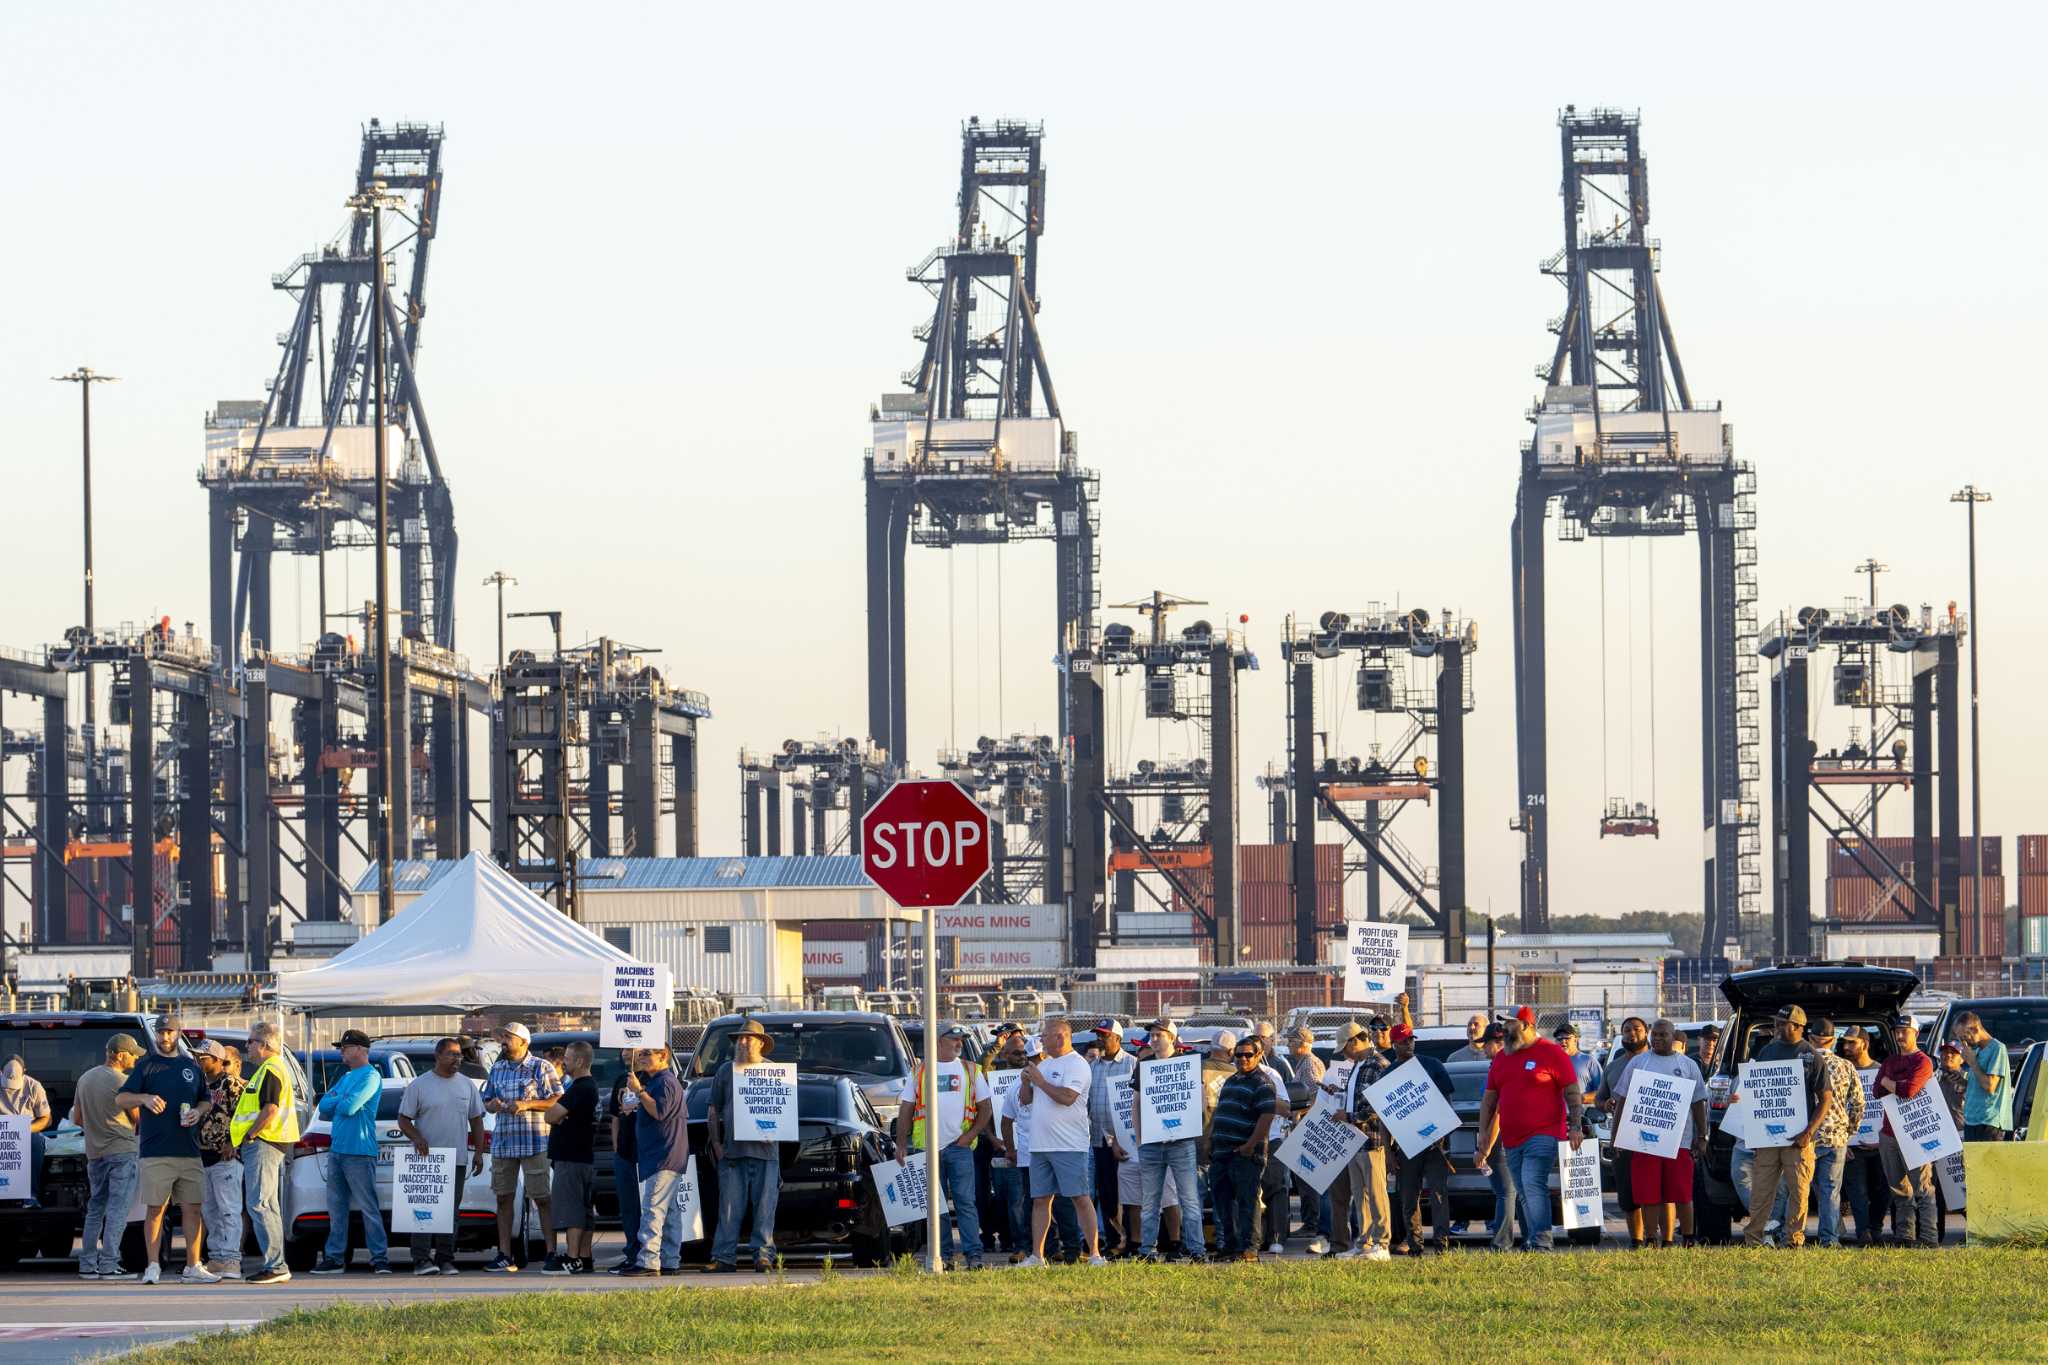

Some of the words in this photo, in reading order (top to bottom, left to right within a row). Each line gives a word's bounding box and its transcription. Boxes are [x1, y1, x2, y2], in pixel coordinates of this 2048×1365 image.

[1528, 794, 1544, 806] 214
[872, 821, 980, 868] STOP
[944, 916, 984, 928] YANG
[990, 916, 1031, 928] MING
[1359, 928, 1380, 936] PROFIT
[1382, 929, 1398, 938] OVER
[1362, 938, 1385, 946] PEOPLE
[960, 952, 984, 964] NG
[990, 952, 1031, 964] MING
[1352, 946, 1402, 958] UNACCEPTABLE:
[803, 953, 843, 964] MING
[1357, 957, 1384, 966] SUPPORT
[616, 966, 654, 976] MACHINES
[1360, 967, 1391, 976] WORKERS
[614, 979, 635, 987] DON'T
[638, 980, 654, 988] FEED
[616, 990, 652, 999] FAMILIES:
[610, 1002, 642, 1011] SUPPORT
[646, 1003, 657, 1012] ILA
[616, 1014, 652, 1023] WORKERS
[1150, 1064, 1172, 1075] PROFIT
[1174, 1062, 1190, 1072] OVER
[1750, 1066, 1792, 1078] AUTOMATION
[748, 1078, 773, 1086] PEOPLE
[1156, 1074, 1178, 1084] PEOPLE
[1180, 1072, 1186, 1080] IS
[1744, 1080, 1766, 1088] HURTS
[1767, 1076, 1800, 1086] FAMILIES:
[1146, 1081, 1196, 1096] UNACCEPTABLE:
[1653, 1079, 1672, 1090] FIGHT
[739, 1087, 792, 1096] UNACCEPTABLE:
[1386, 1092, 1396, 1103] NO
[1395, 1080, 1416, 1096] WORK
[1638, 1086, 1681, 1102] AUTOMATION,
[1754, 1090, 1765, 1098] ILA
[1766, 1088, 1792, 1098] STANDS
[744, 1096, 774, 1104] SUPPORT
[1152, 1093, 1179, 1104] SUPPORT
[1181, 1092, 1191, 1100] ILA
[1382, 1096, 1410, 1117] WITHOUT
[1414, 1082, 1430, 1096] FAIR
[1640, 1096, 1657, 1107] SAVE
[1657, 1100, 1676, 1110] JOBS:
[1760, 1099, 1774, 1108] FOR
[1774, 1098, 1786, 1108] JOB
[749, 1106, 782, 1114] WORKERS
[1156, 1102, 1188, 1114] WORKERS
[1396, 1096, 1428, 1120] CONTRACT
[1898, 1101, 1916, 1115] DON'T
[1916, 1096, 1932, 1109] FEED
[1633, 1105, 1644, 1114] ILA
[1645, 1108, 1678, 1120] DEMANDS
[1754, 1108, 1795, 1119] PROTECTION
[1904, 1106, 1934, 1122] FAMILIES:
[1630, 1114, 1642, 1124] JOB
[1643, 1117, 1676, 1130] SECURITY
[1903, 1116, 1930, 1133] SUPPORT
[1930, 1113, 1941, 1124] ILA
[1320, 1120, 1340, 1140] PEOPLE
[1340, 1135, 1346, 1144] IS
[1340, 1123, 1356, 1140] OVER
[1910, 1123, 1940, 1140] WORKERS
[1305, 1120, 1348, 1156] UNACCEPTABLE:
[1304, 1130, 1330, 1154] SUPPORT
[1328, 1150, 1338, 1161] ILA
[1302, 1140, 1330, 1164] WORKERS
[428, 1154, 445, 1163] OVER
[409, 1164, 432, 1173] PEOPLE
[434, 1164, 440, 1173] IS
[399, 1174, 449, 1184] UNACCEPTABLE:
[1568, 1178, 1584, 1188] DEFEND
[1585, 1178, 1594, 1187] OUR
[404, 1184, 432, 1194] SUPPORT
[434, 1186, 444, 1194] ILA
[896, 1174, 910, 1206] WORKERS
[1575, 1190, 1584, 1198] AND
[408, 1195, 438, 1204] WORKERS
